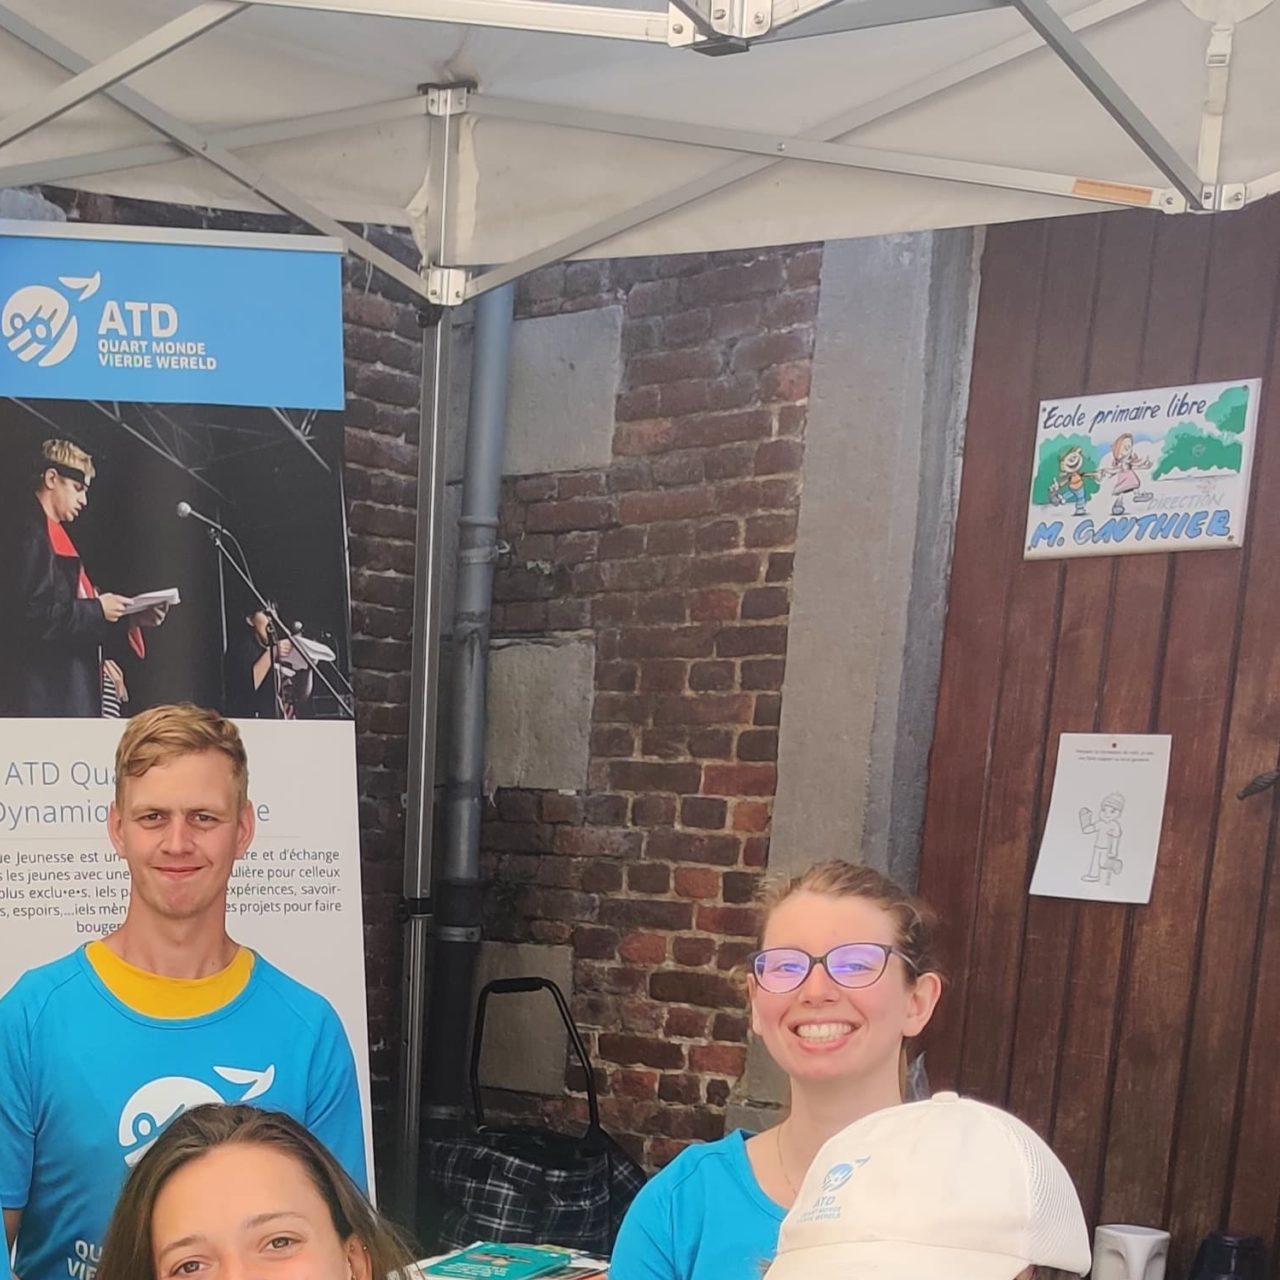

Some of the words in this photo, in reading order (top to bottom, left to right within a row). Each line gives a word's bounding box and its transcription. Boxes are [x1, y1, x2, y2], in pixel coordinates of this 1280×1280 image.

[98, 300, 178, 337] ATD
[98, 339, 148, 353] QUART
[152, 341, 206, 355] MONDE
[99, 353, 152, 368] VIERDE
[156, 356, 217, 370] WERELD
[1088, 401, 1161, 432] primaire
[1167, 392, 1207, 418] libre
[1031, 521, 1065, 548] M.
[1073, 510, 1231, 545] GAUTHIER
[4, 761, 60, 786] ATD
[15, 852, 75, 867] Jeunesse
[80, 852, 99, 863] est
[262, 850, 275, 861] et
[279, 848, 340, 864] d'échange
[6, 869, 25, 881] les
[27, 870, 70, 884] jeunes
[73, 870, 103, 881] avec
[106, 870, 130, 881] une
[231, 865, 264, 878] ulière
[267, 867, 296, 881] pour
[299, 865, 341, 878] celleux
[301, 884, 341, 895] savoir-
[99, 902, 127, 916] mèn
[240, 902, 281, 916] projets
[284, 902, 312, 914] pour
[315, 899, 342, 912] faire
